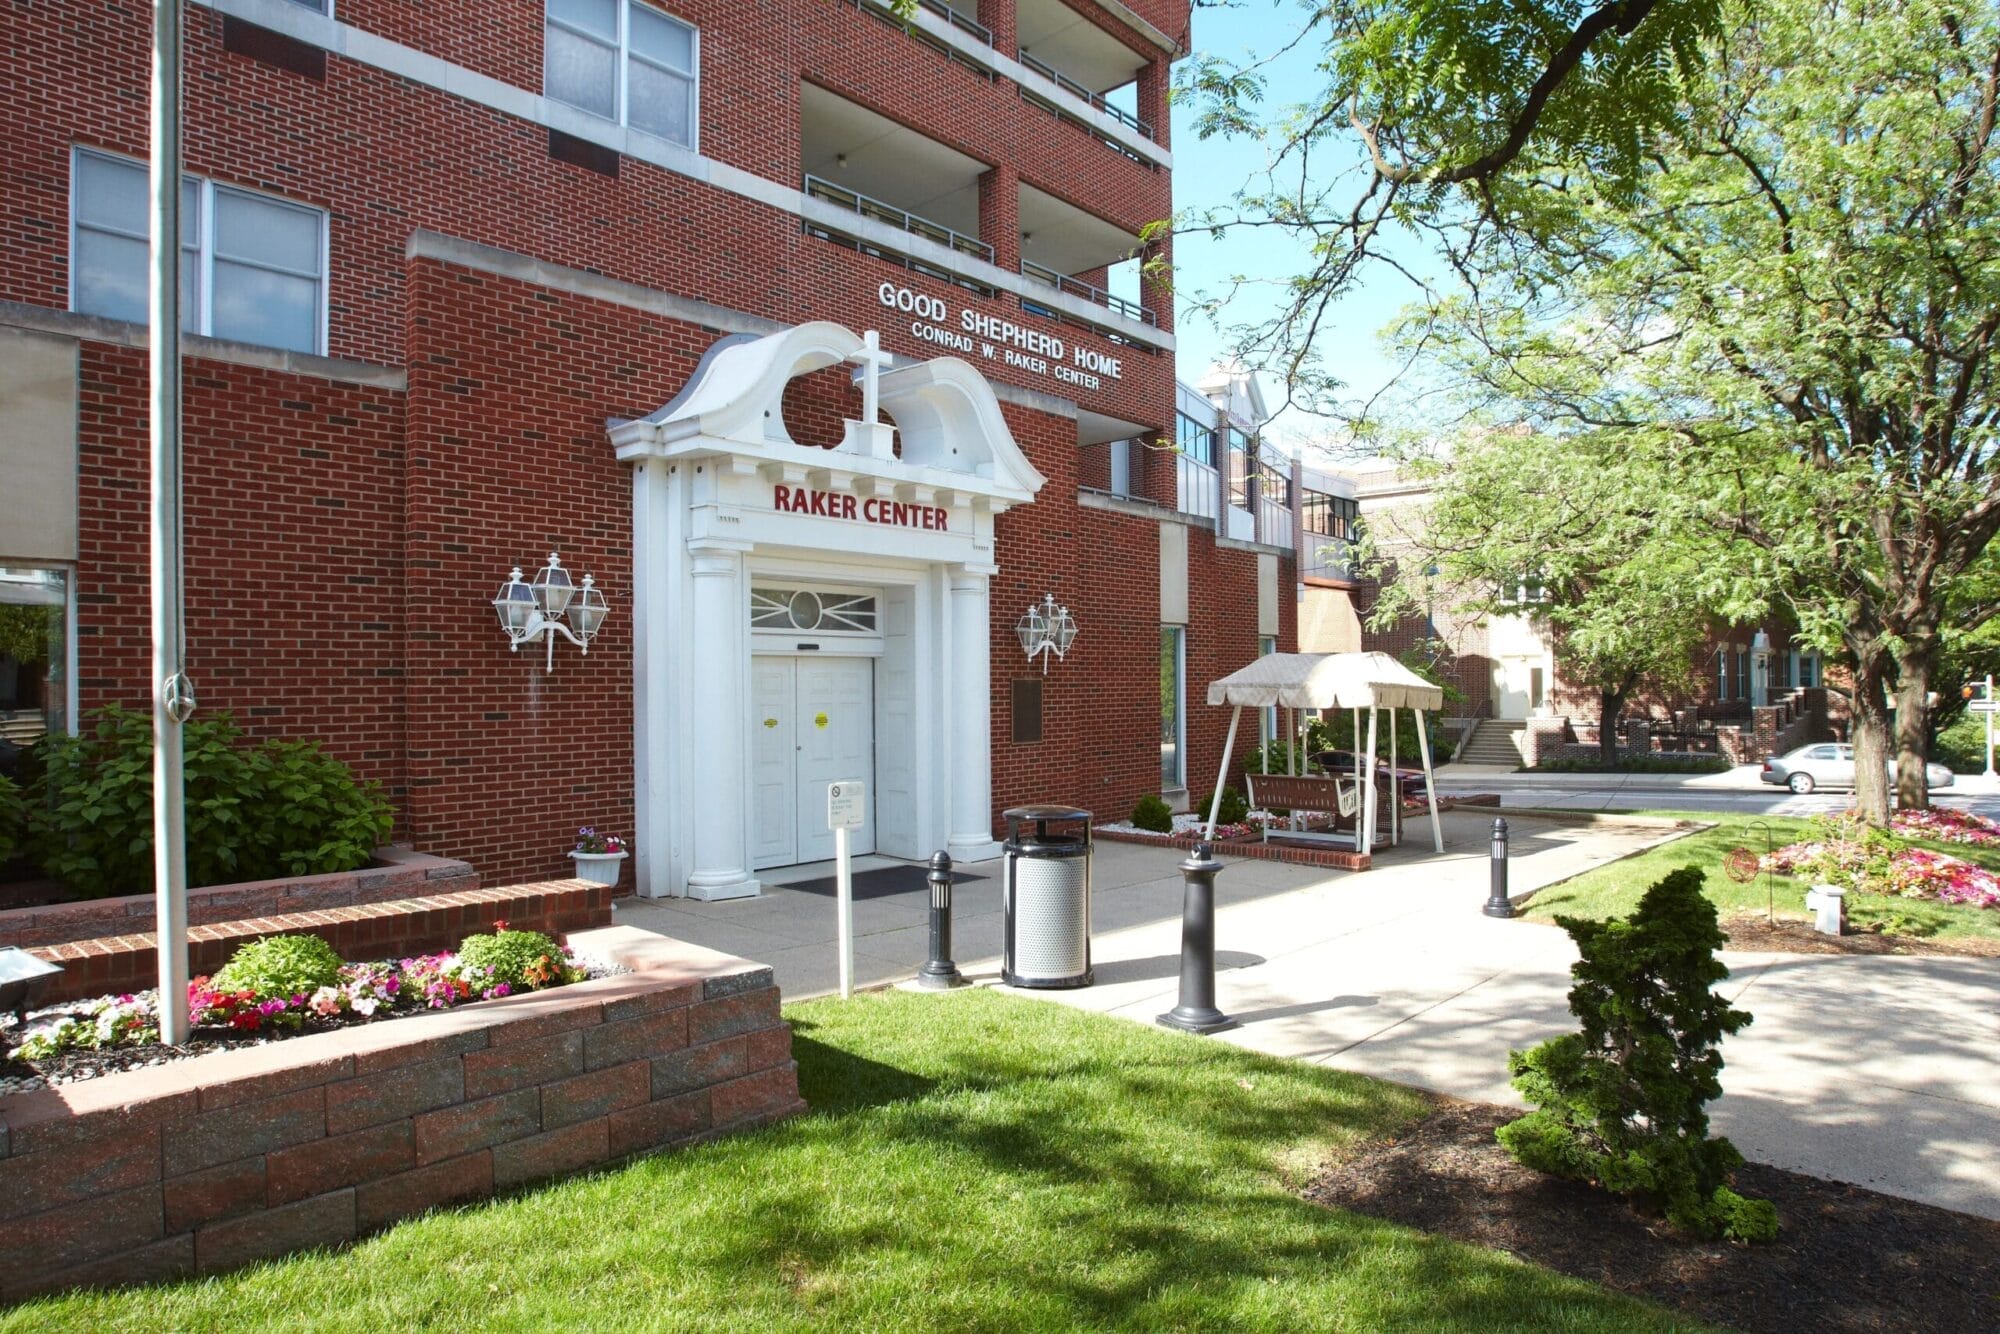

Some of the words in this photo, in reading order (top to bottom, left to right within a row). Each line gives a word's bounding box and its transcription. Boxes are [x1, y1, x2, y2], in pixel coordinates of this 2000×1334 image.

[878, 282, 946, 322] GOOD
[960, 309, 1064, 360] SHEPHERD
[1074, 346, 1122, 379] HOME
[911, 321, 973, 353] CONRAD
[981, 342, 997, 360] W.
[1005, 350, 1047, 375] RAKER
[1054, 365, 1100, 391] CENTER
[773, 484, 857, 520] RAKER
[863, 498, 949, 531] CENTER
